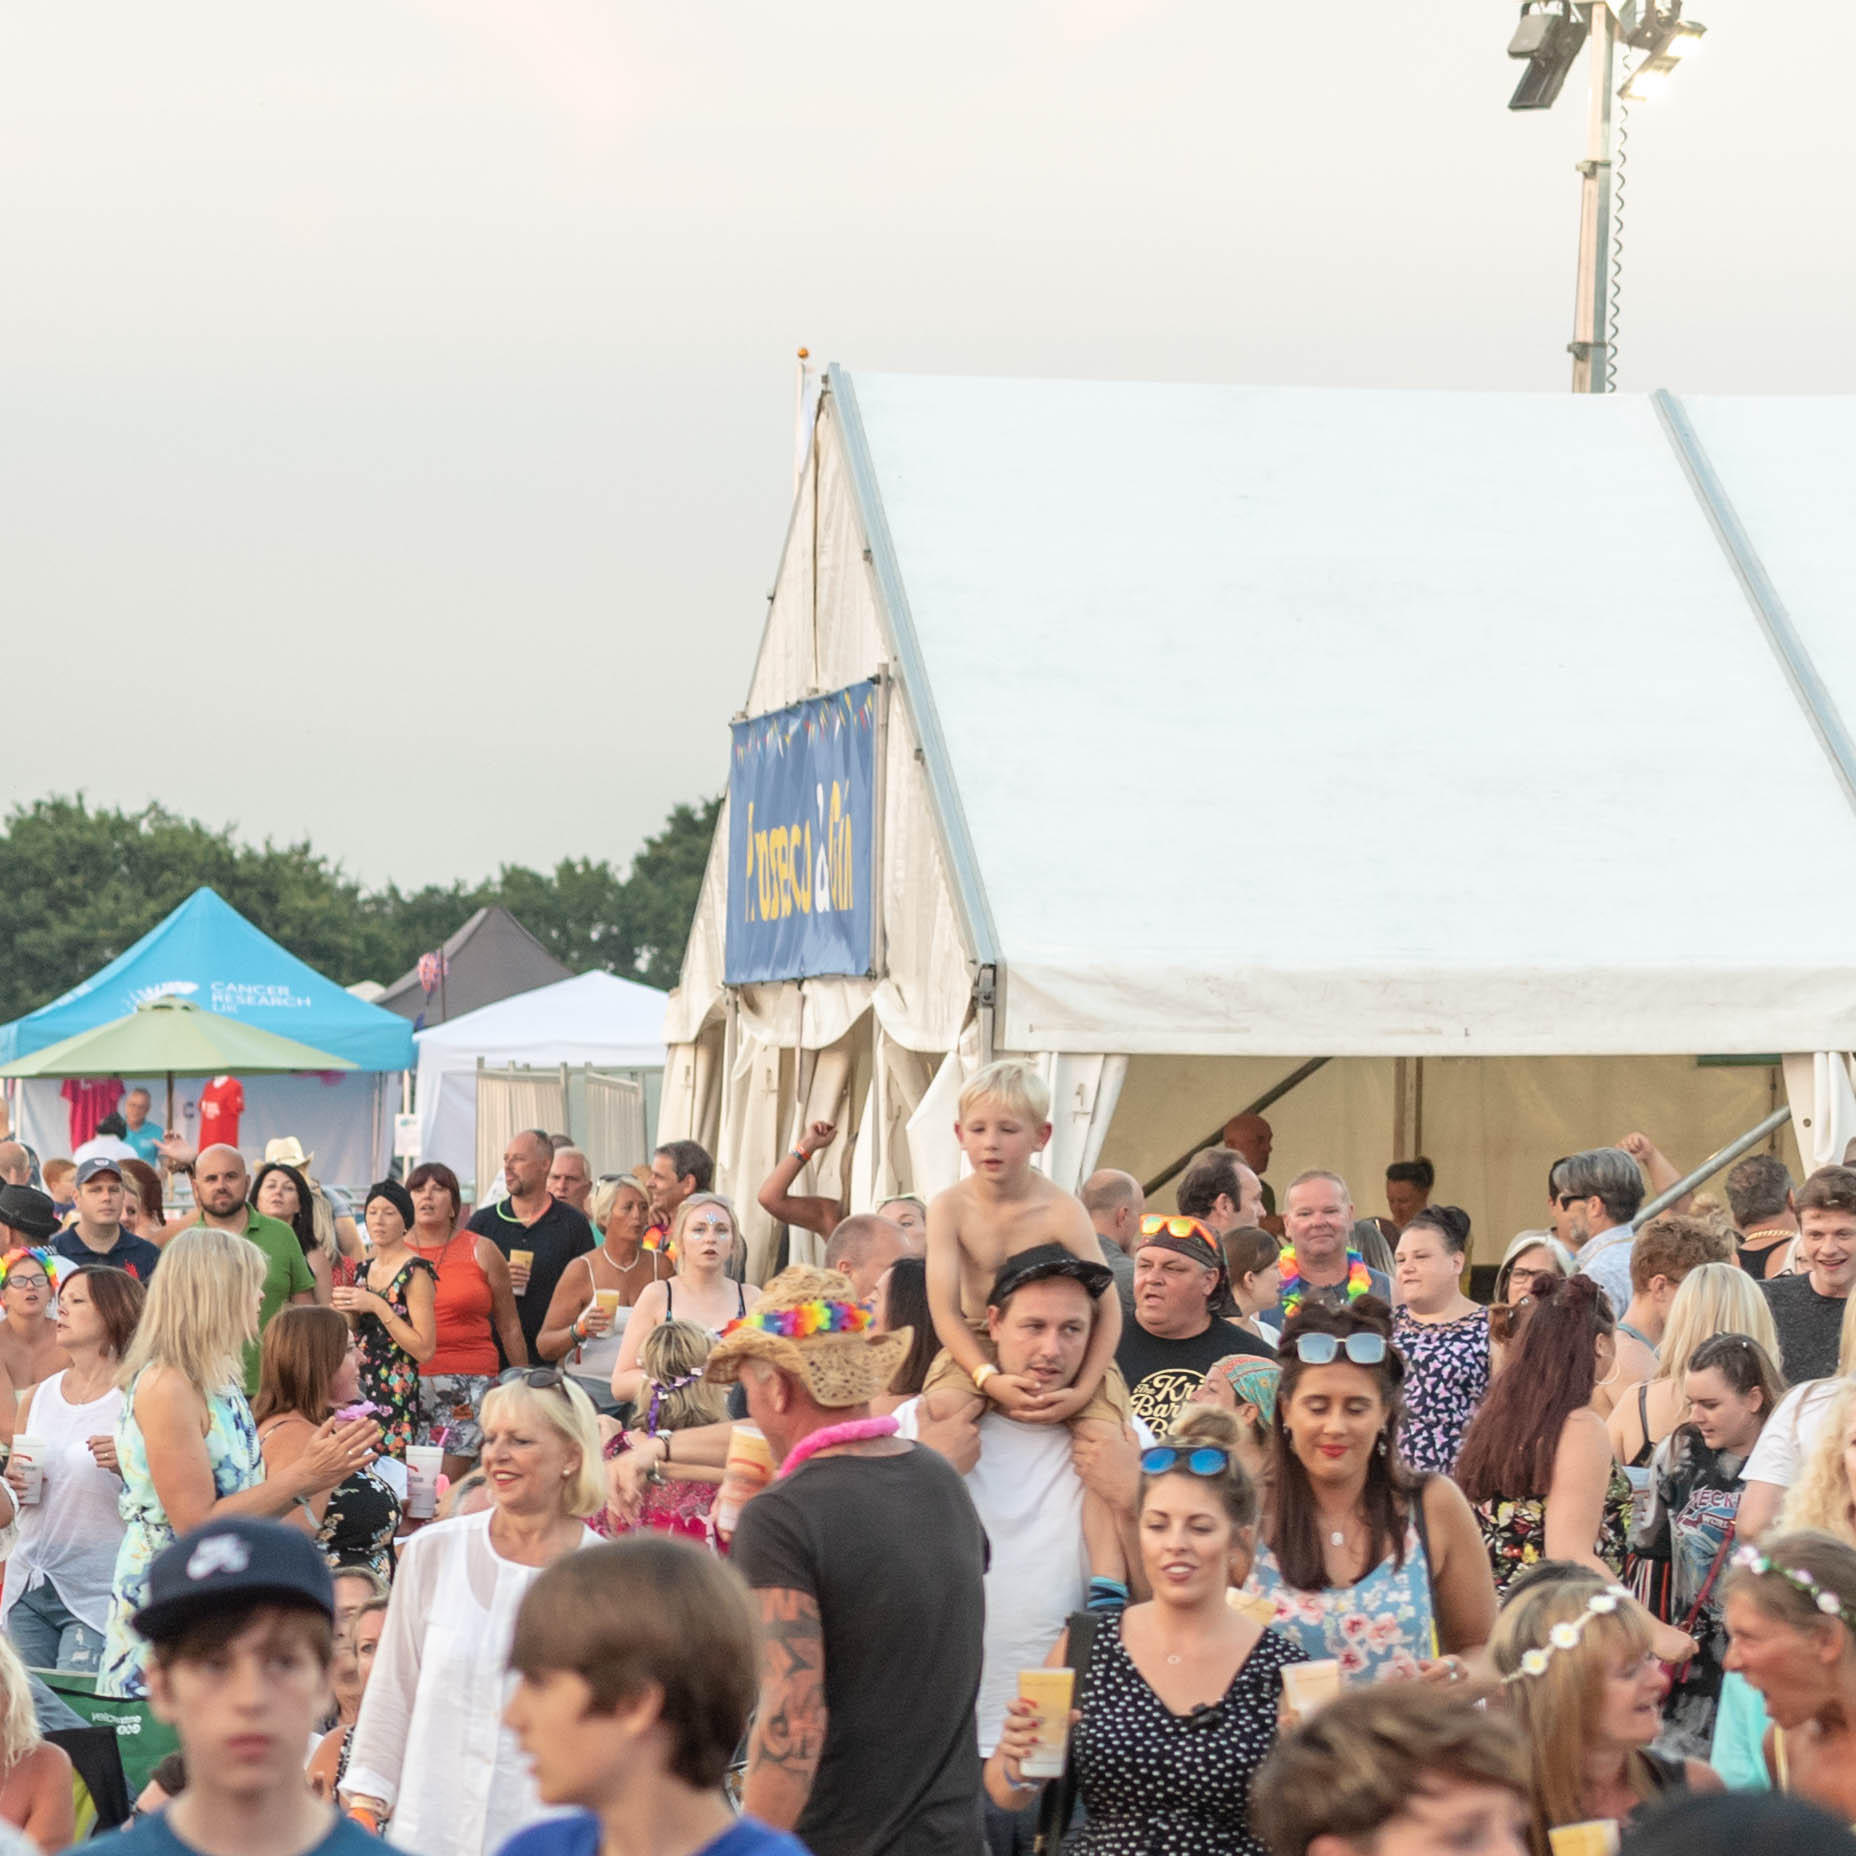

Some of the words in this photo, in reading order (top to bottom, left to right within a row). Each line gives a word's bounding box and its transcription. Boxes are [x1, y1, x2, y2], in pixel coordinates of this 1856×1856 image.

[210, 981, 290, 996] CANCER
[211, 992, 312, 1008] RESEARCH
[212, 1002, 238, 1013] UK
[1153, 1375, 1205, 1403] Kri
